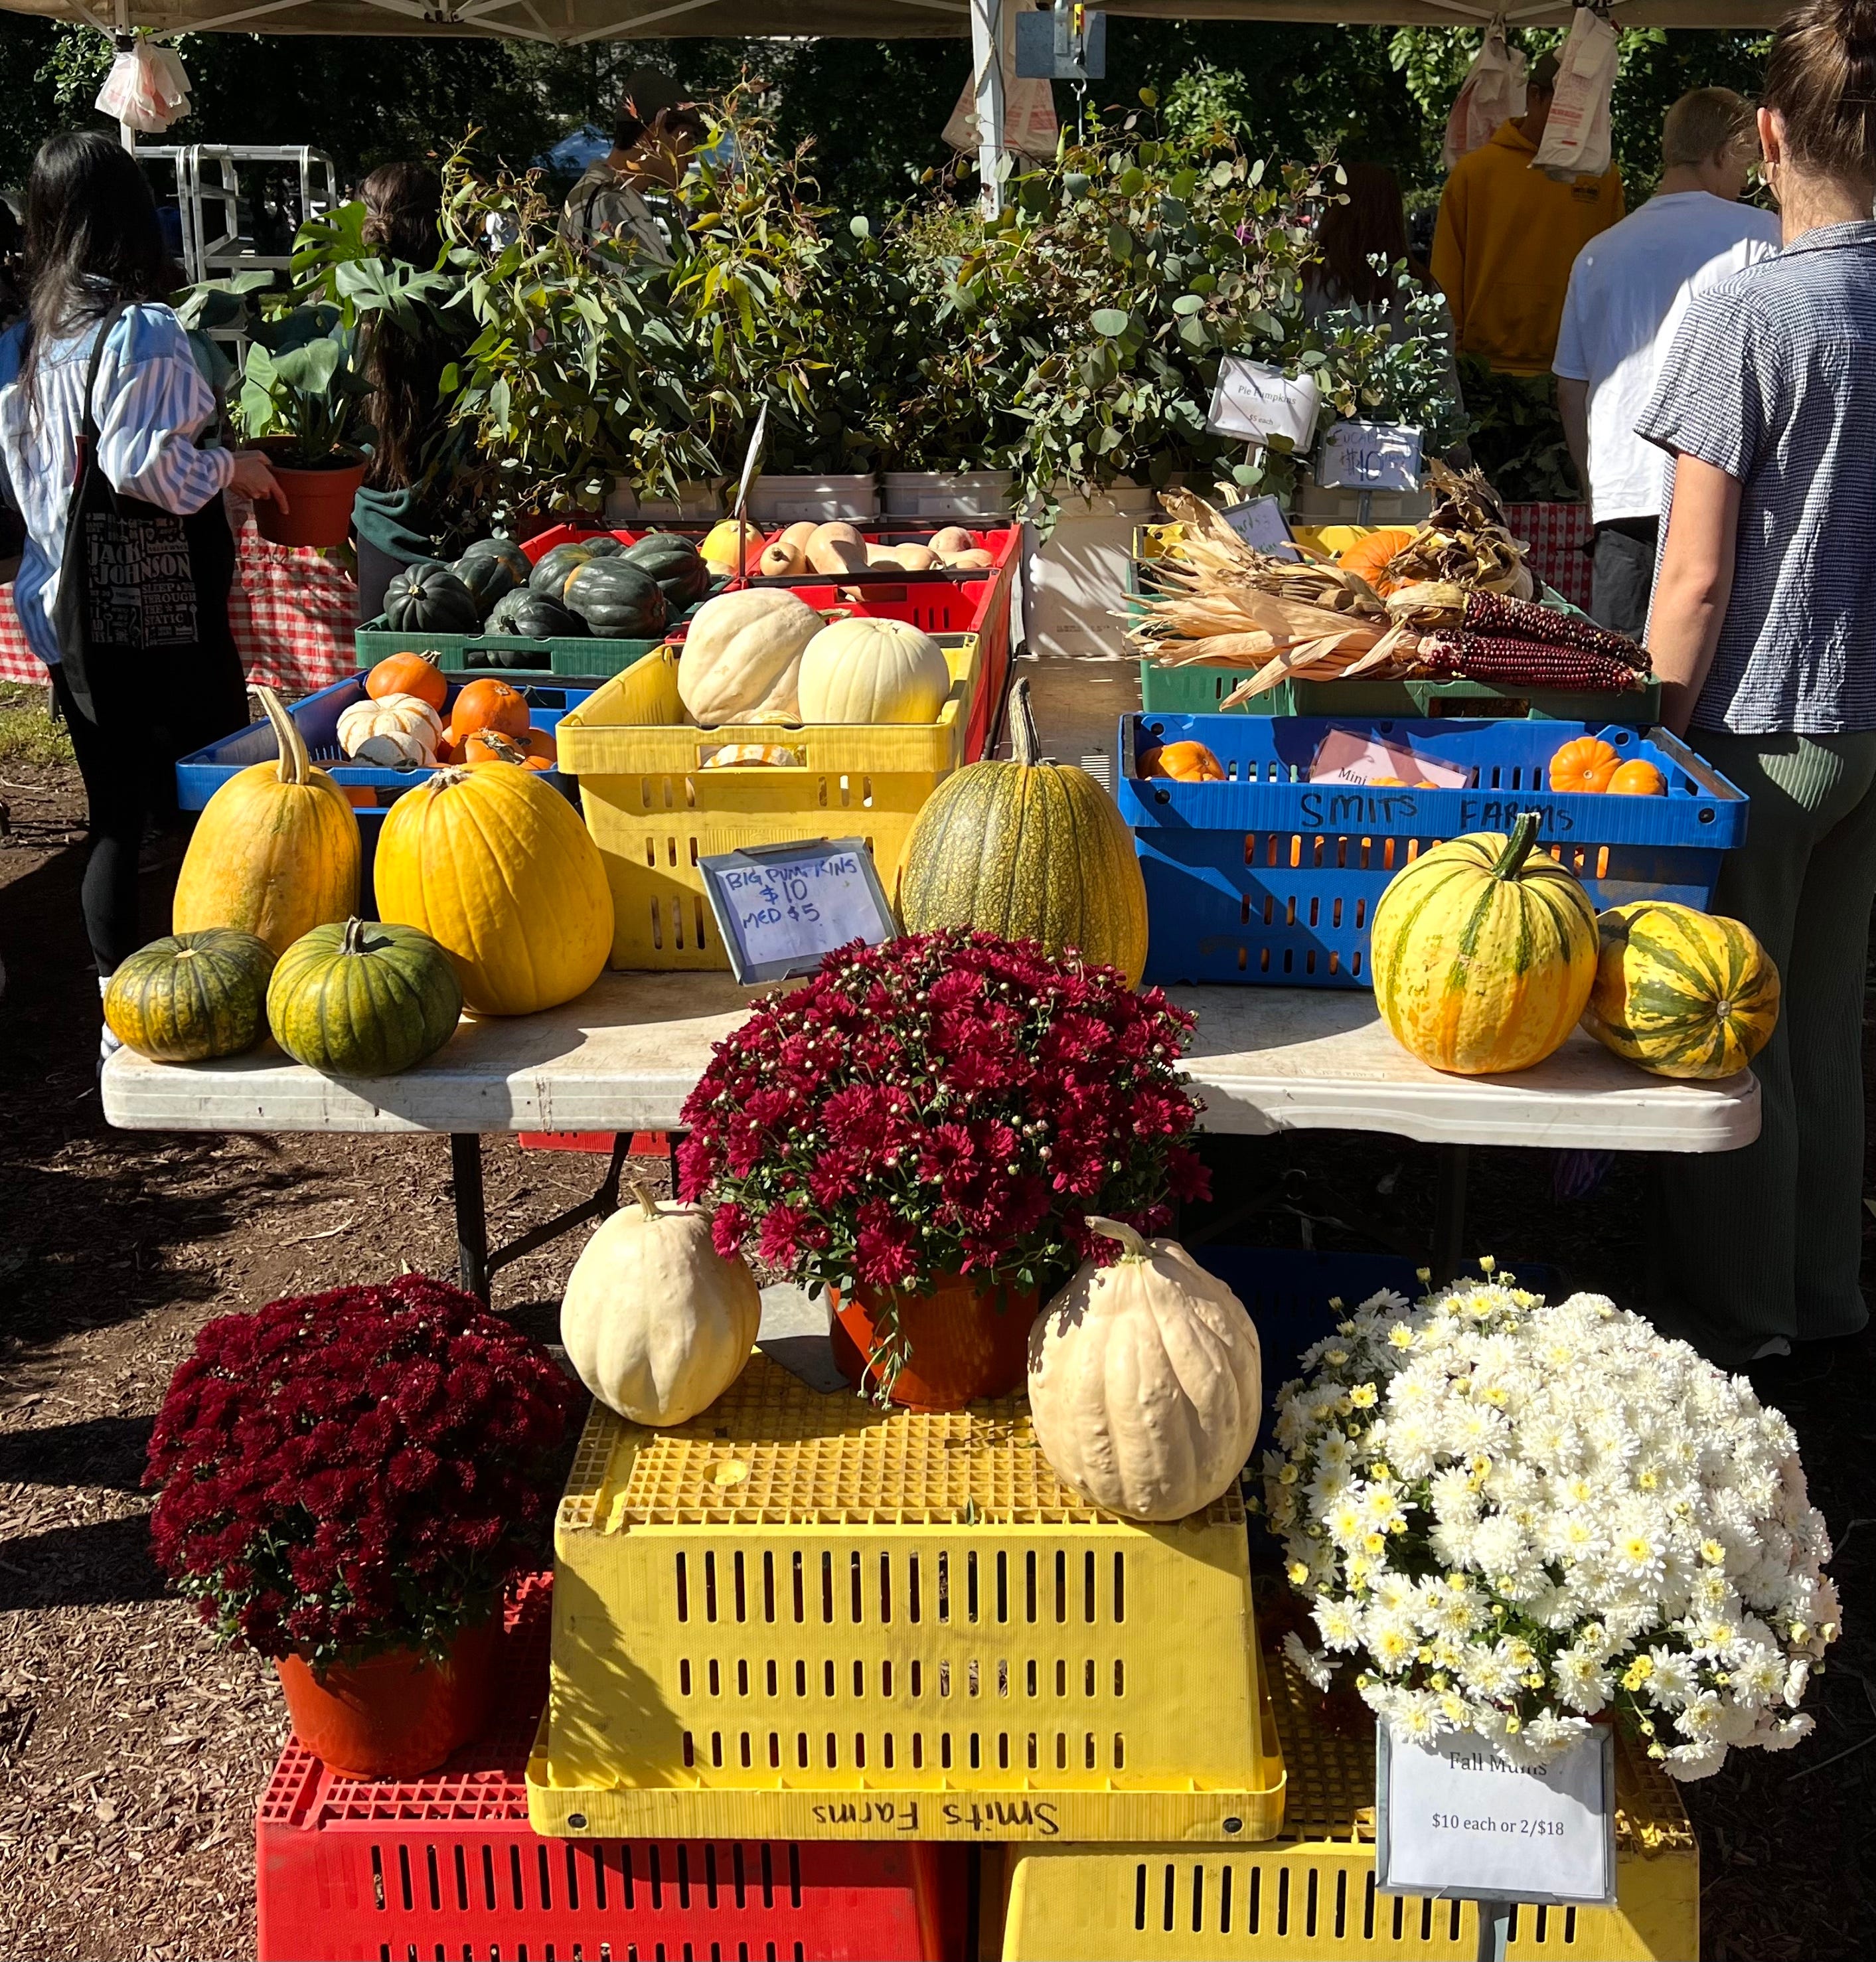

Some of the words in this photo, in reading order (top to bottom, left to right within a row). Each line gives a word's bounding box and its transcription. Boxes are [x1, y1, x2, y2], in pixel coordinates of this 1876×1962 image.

[1237, 384, 1252, 395] Pie
[88, 540, 141, 566] JACK
[94, 553, 193, 585] JOHNSON
[142, 583, 174, 594] SLEEP
[142, 592, 196, 604] THROUGH
[144, 605, 163, 615] THE
[145, 613, 184, 625] STATIC
[1338, 767, 1368, 785] Mini
[1301, 791, 1418, 828] SMITS
[1461, 799, 1574, 833] FARMS
[726, 871, 763, 891] BIG
[765, 857, 858, 883] PUMKINS
[759, 878, 808, 905] $10
[743, 908, 782, 929] MED
[1449, 1752, 1484, 1771] Fall
[812, 1801, 919, 1833] Farms
[942, 1800, 1059, 1835] Smits
[1432, 1813, 1459, 1829] $10
[1463, 1817, 1496, 1832] each
[1500, 1821, 1517, 1833] or
[1520, 1819, 1565, 1838] 2/$18
